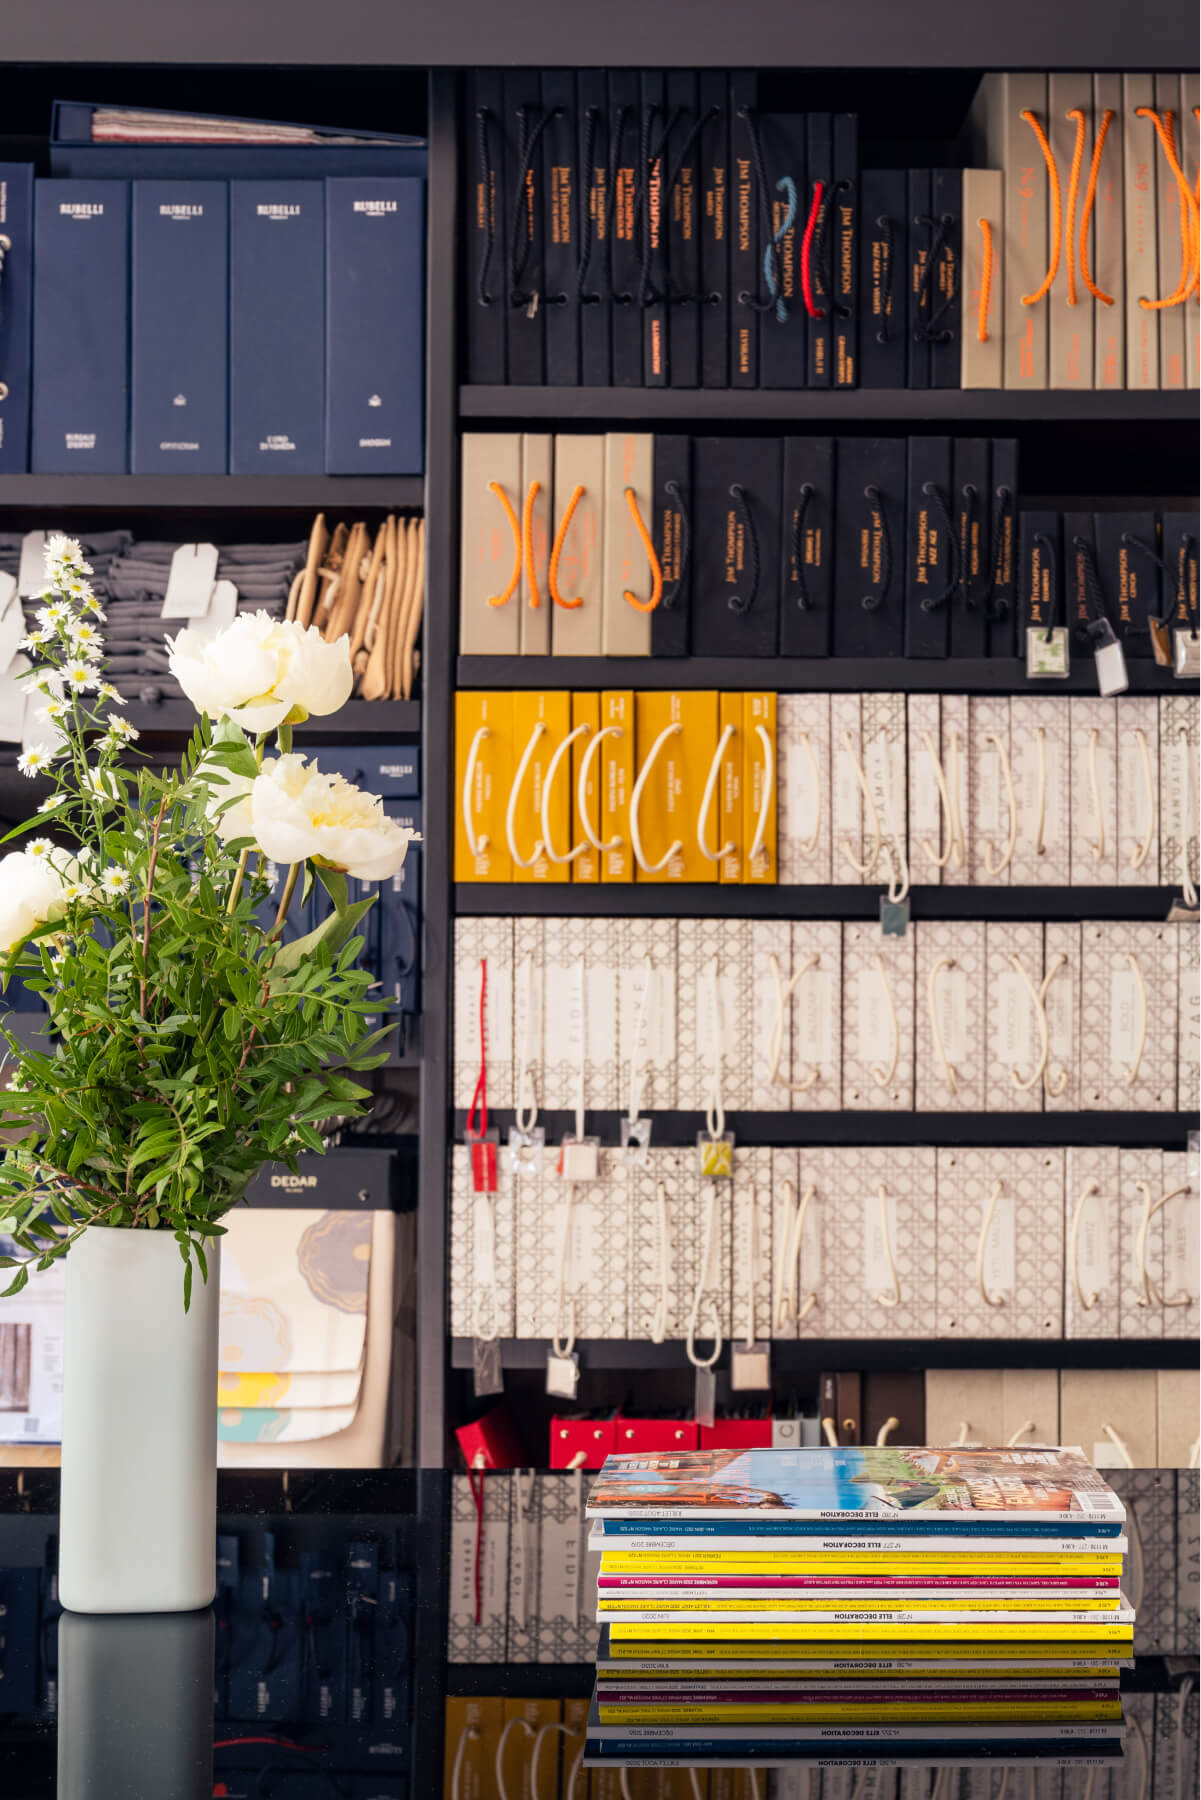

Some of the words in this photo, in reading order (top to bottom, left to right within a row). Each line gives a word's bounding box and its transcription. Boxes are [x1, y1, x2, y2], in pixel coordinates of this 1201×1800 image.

[558, 167, 570, 185] JIM
[594, 168, 606, 184] JIM
[624, 168, 634, 185] JIM
[682, 168, 692, 184] JIM
[713, 168, 724, 184] JIM
[738, 158, 750, 179] JIM
[560, 187, 571, 243] THOMPSON
[596, 187, 606, 240] THOMPSON
[626, 187, 635, 240] THOMPSON
[683, 187, 693, 240] THOMPSON
[714, 187, 724, 240] THOMPSON
[739, 182, 751, 250] THOMPSON
[839, 206, 852, 227] JIM
[783, 228, 794, 297] THOMPSON
[841, 230, 852, 294] THOMPSON
[662, 510, 671, 563] THOMPSON
[726, 511, 736, 564] THOMPSON
[917, 511, 928, 565] THOMPSON
[663, 566, 672, 581] JIM
[872, 529, 883, 583] THOMPSON
[725, 567, 736, 583] JIM
[916, 568, 928, 584] JIM
[1030, 548, 1040, 602] THOMPSON
[1119, 549, 1128, 602] THOMPSON
[1031, 605, 1042, 621] JIM
[1120, 605, 1130, 621] JIM
[1178, 603, 1188, 619] JIM
[270, 1175, 318, 1188] DEDAR
